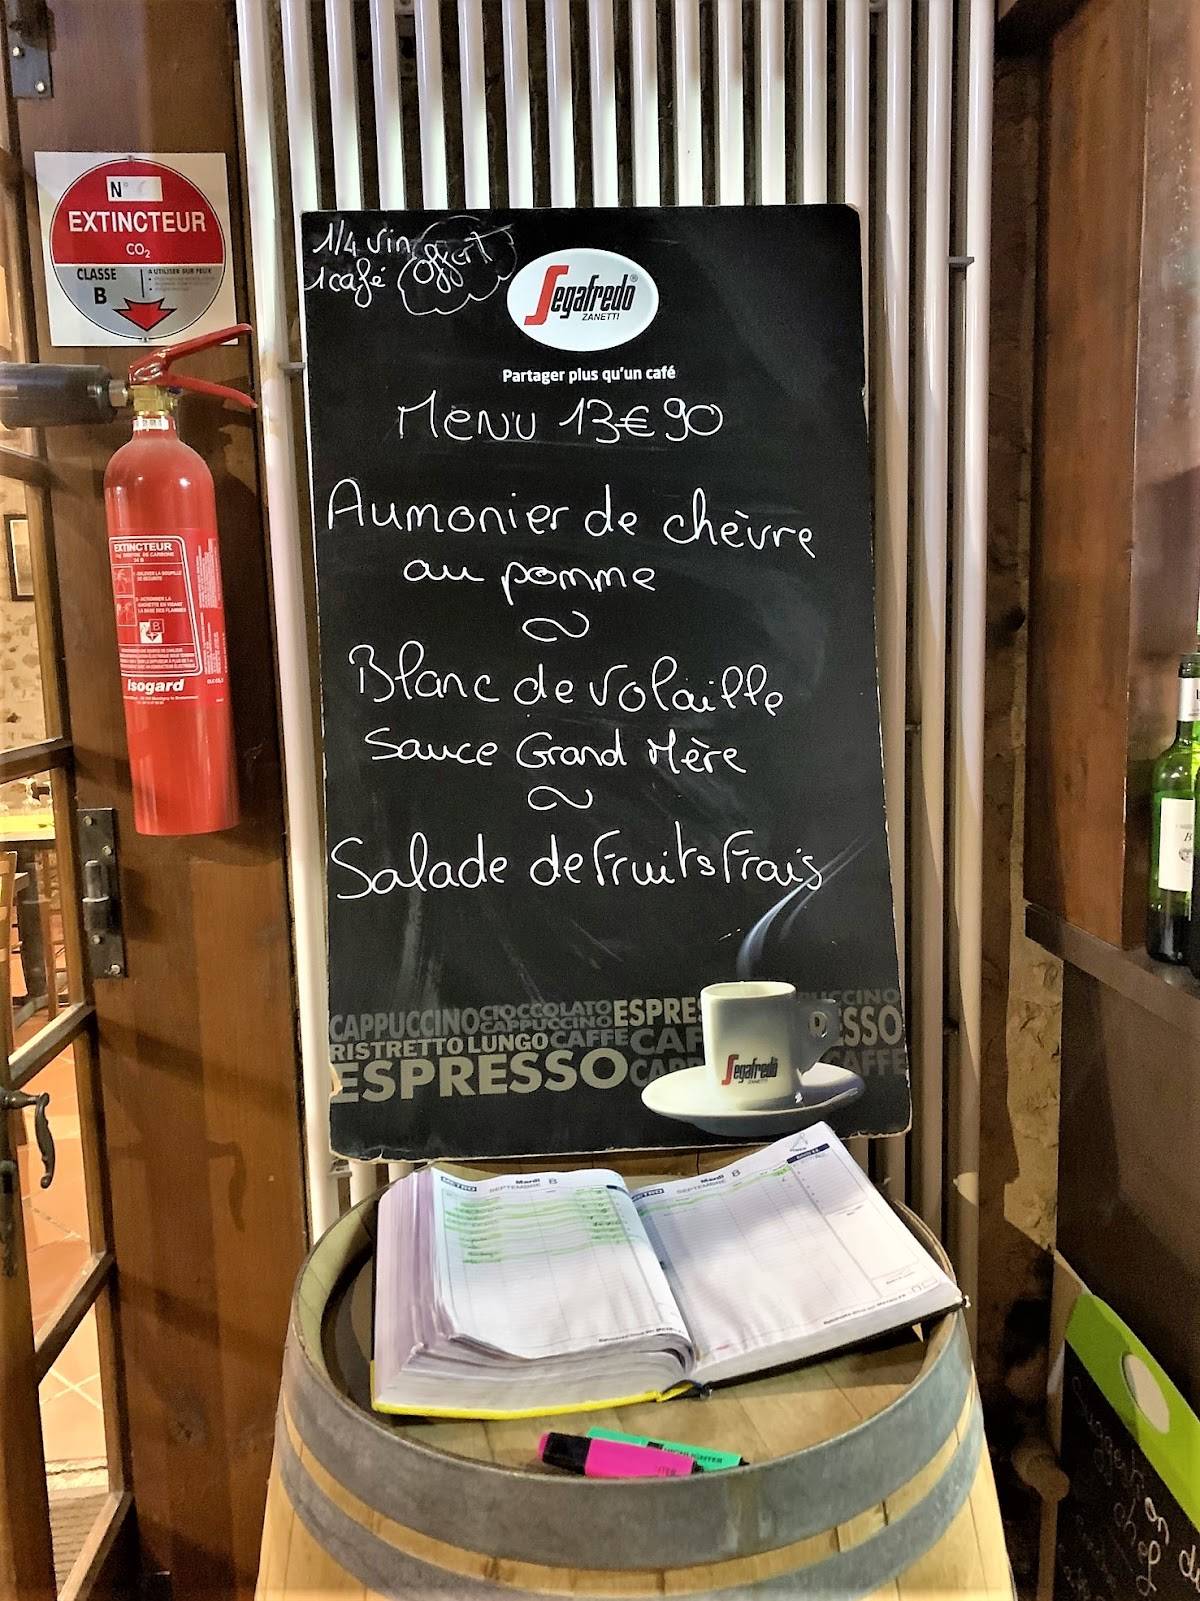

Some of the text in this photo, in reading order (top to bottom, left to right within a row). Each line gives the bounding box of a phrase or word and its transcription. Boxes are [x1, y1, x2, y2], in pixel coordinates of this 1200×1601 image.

[68, 210, 207, 233] EXTINCTEUR
[313, 219, 356, 257] 1/4
[76, 267, 118, 281] CLASSE
[93, 286, 108, 305] B
[582, 312, 621, 321] ZANETTI
[502, 364, 677, 385] Partager plus qu'un café
[328, 478, 817, 559] Aumonier de chèvre
[114, 542, 173, 552] EXTINCTEUR
[403, 558, 657, 606] au pomme
[127, 678, 185, 696] Isogard
[348, 640, 501, 703] Blanc
[513, 663, 574, 706] de
[515, 727, 628, 769] Grand
[647, 727, 747, 774] Mère
[330, 830, 508, 900] Salade
[529, 833, 582, 887] de
[330, 1006, 480, 1043] CAPPUCCINO
[479, 1000, 612, 1022] CIOCCOLATO
[479, 1014, 612, 1034] CAPPUCCINO
[613, 996, 702, 1027] ESPRE
[330, 1028, 629, 1062] RISTRETTO LUNGO CAFFE
[330, 1047, 629, 1105] ESPRESSO
